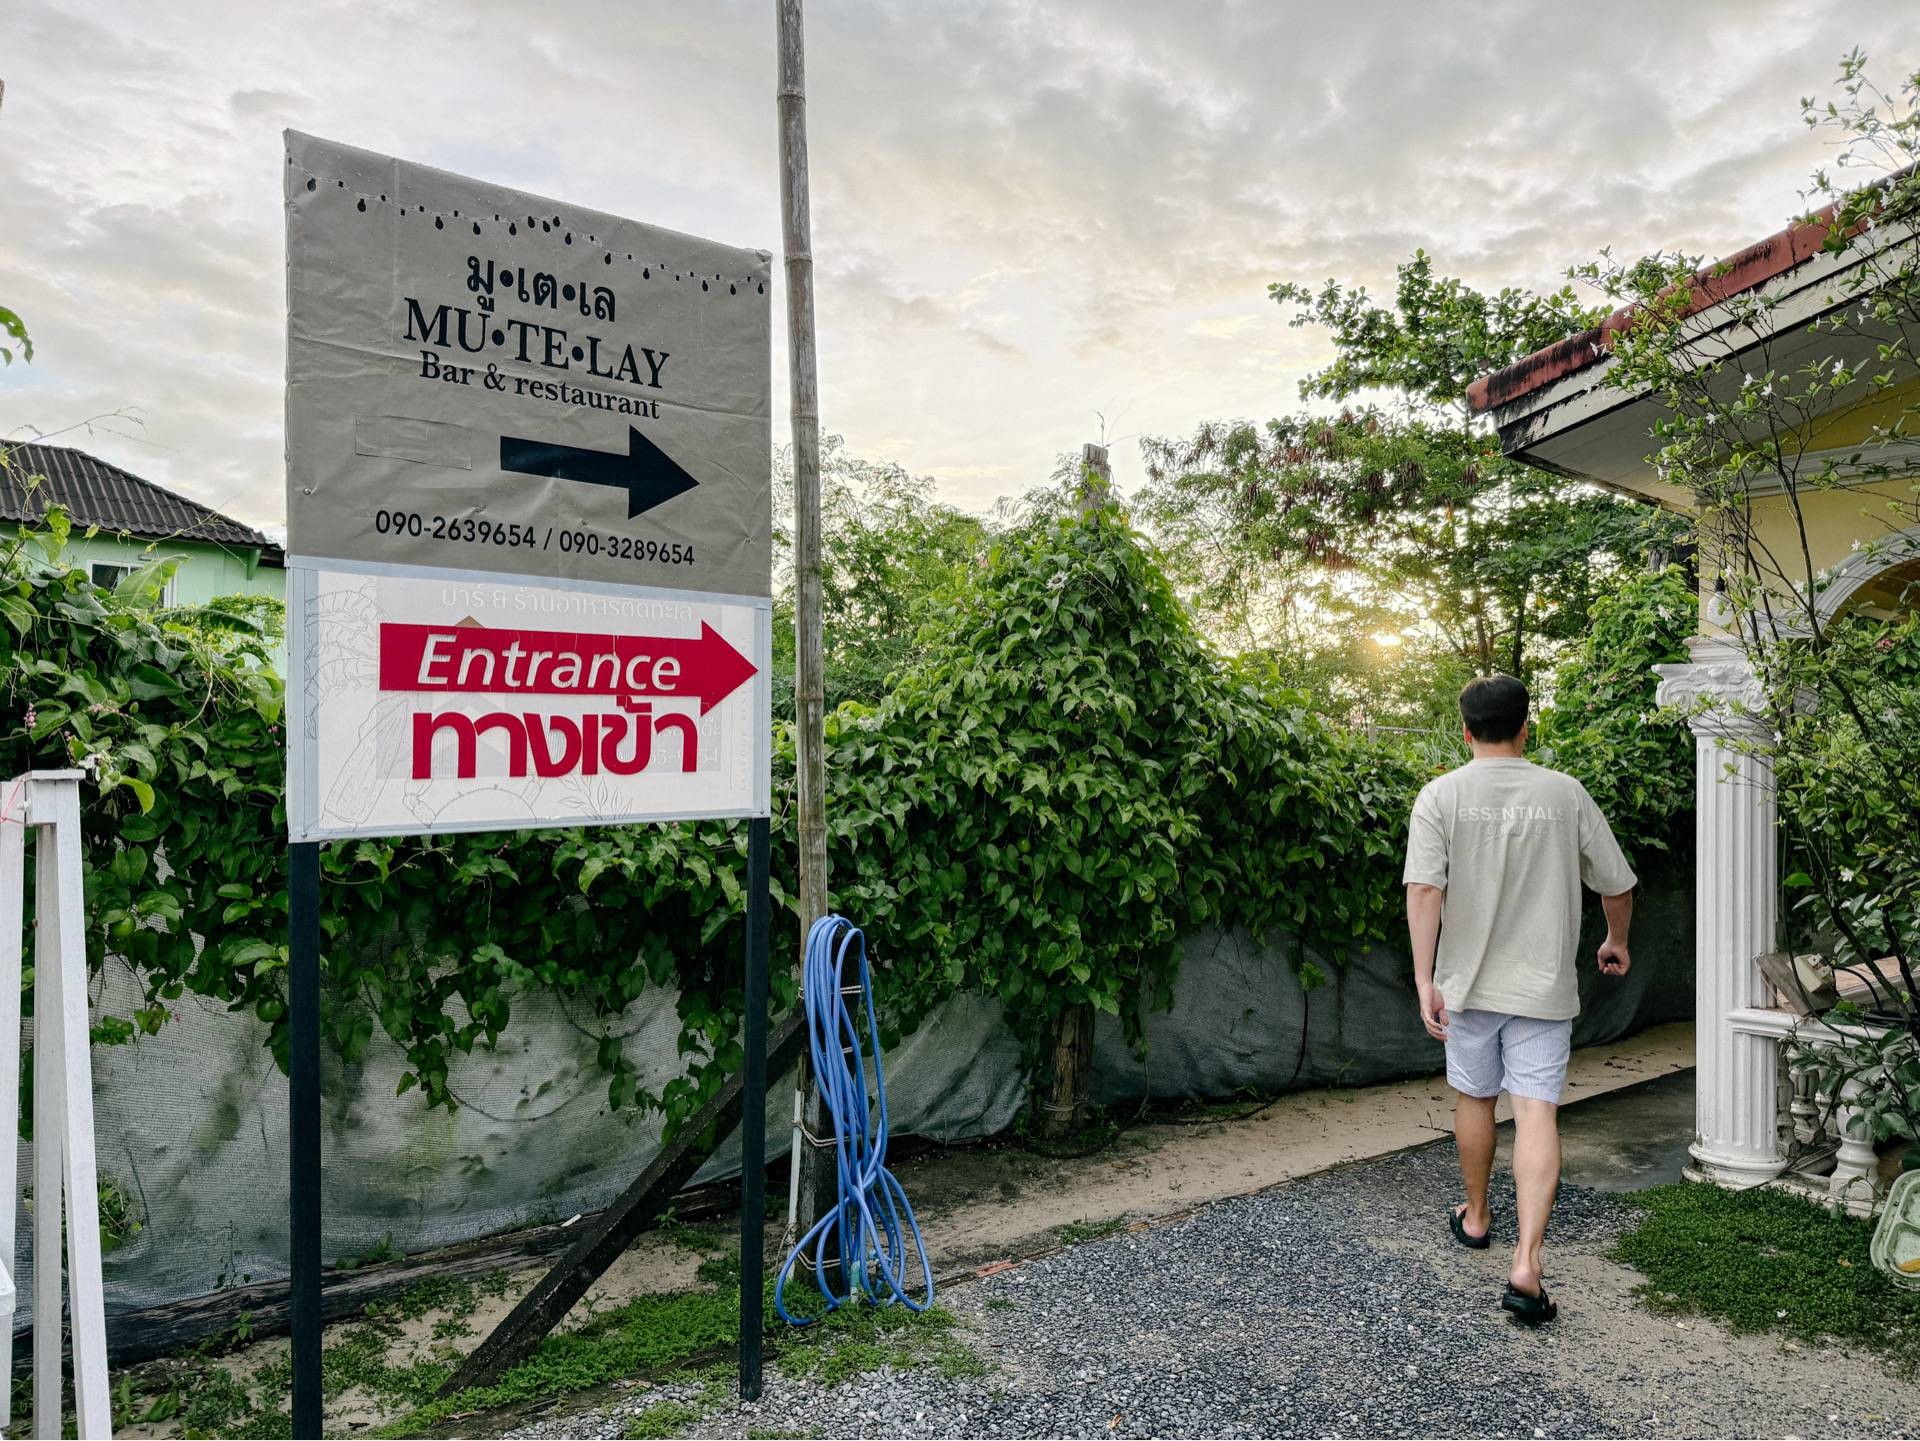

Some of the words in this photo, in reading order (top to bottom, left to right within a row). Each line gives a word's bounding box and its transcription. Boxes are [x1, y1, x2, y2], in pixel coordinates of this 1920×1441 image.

[419, 350, 475, 386] Bar
[484, 362, 507, 391] &
[514, 378, 661, 420] restaurant
[375, 509, 537, 549] 090-2639654
[544, 528, 553, 551] /
[559, 529, 695, 566] 090-3289654
[417, 633, 681, 691] Entrance
[1458, 806, 1568, 822] ESSENTIALS
